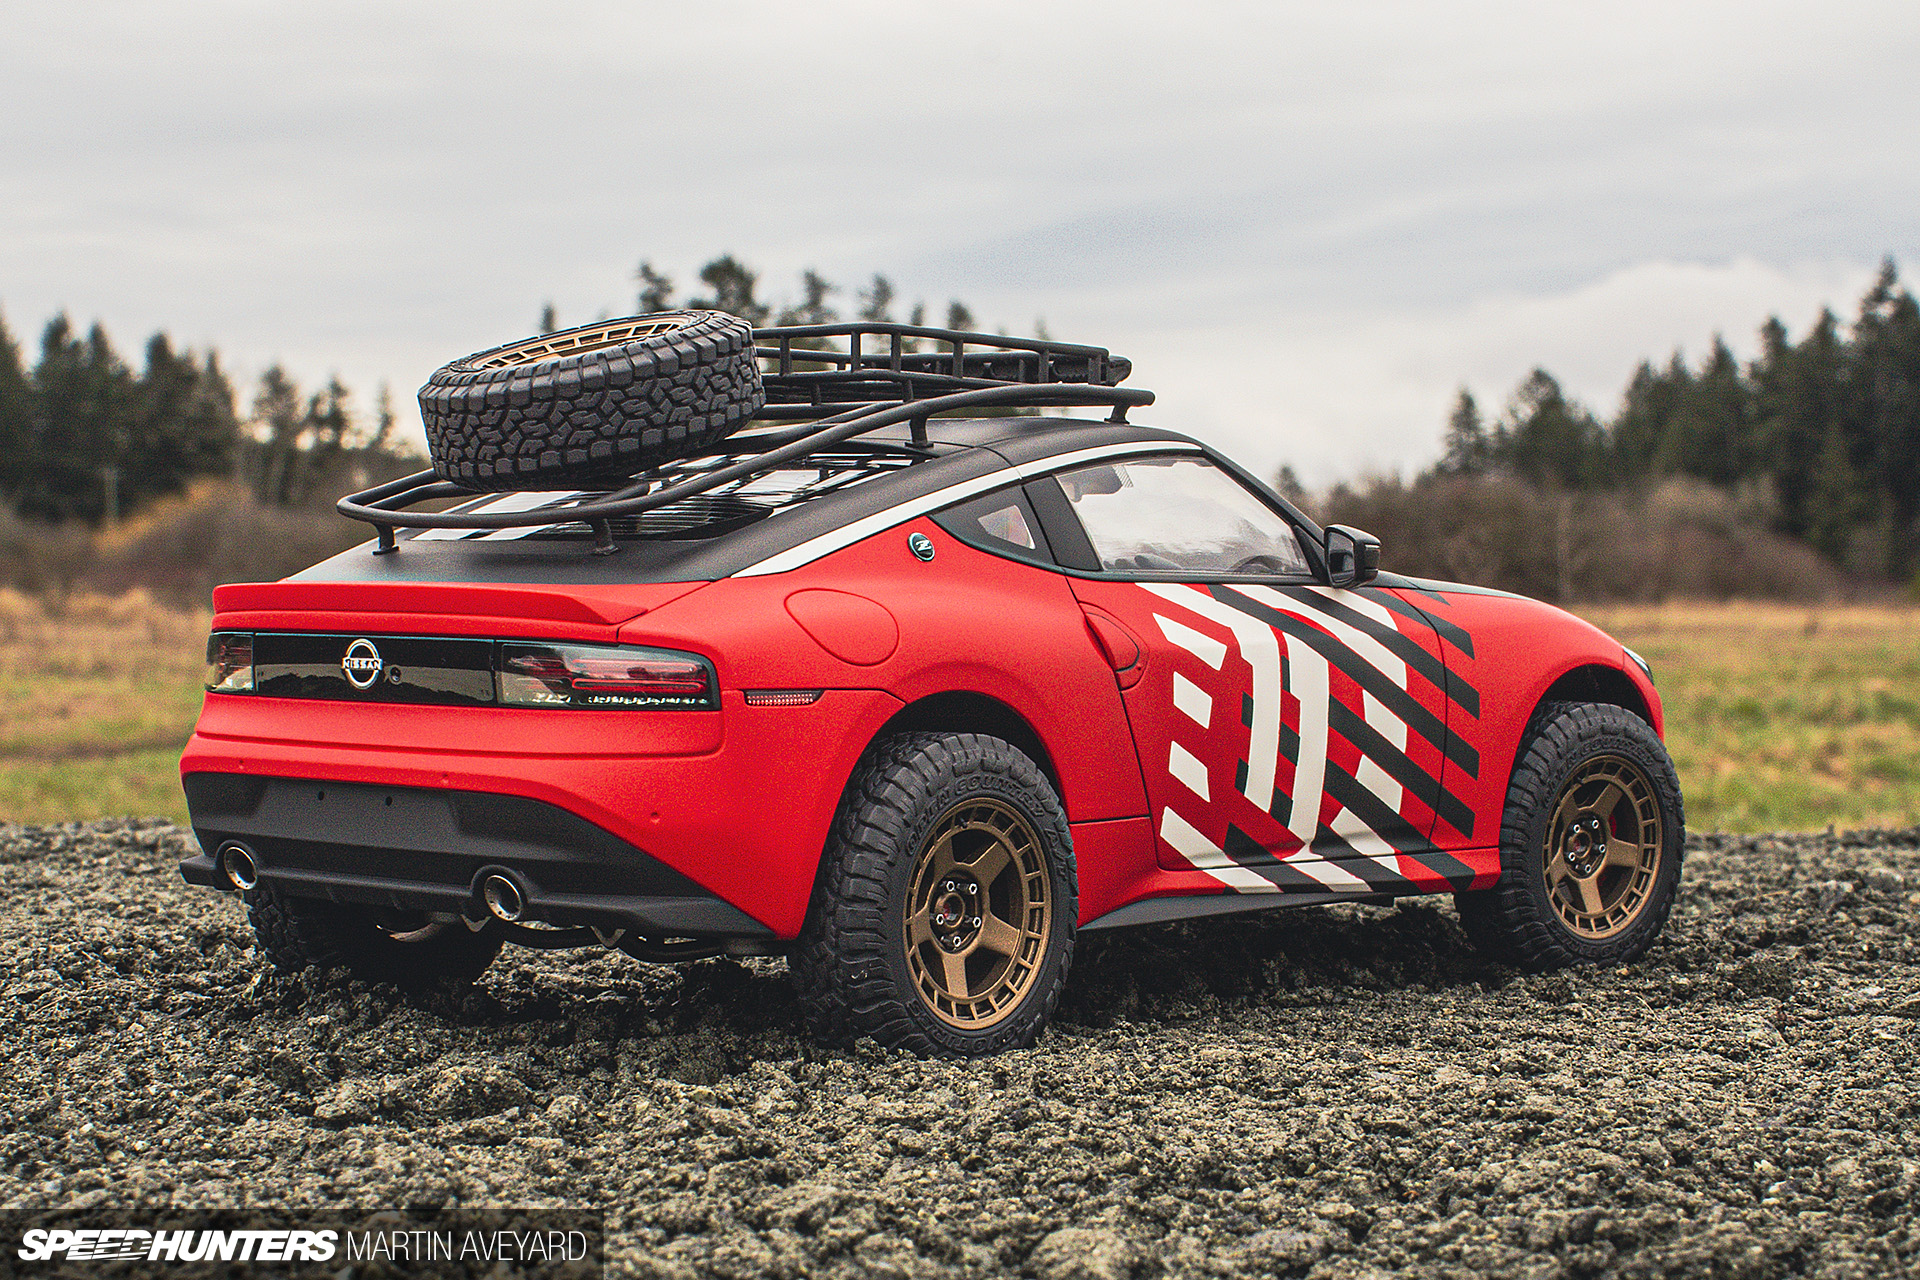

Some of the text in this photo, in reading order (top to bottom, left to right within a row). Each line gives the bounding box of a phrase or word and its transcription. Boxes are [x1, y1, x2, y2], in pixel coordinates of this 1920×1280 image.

[916, 540, 932, 551] Z
[342, 659, 382, 669] NISSAN
[906, 785, 950, 856] OPEN
[954, 774, 1043, 817] COUNTRY
[905, 997, 1027, 1053] TOYO TIRES
